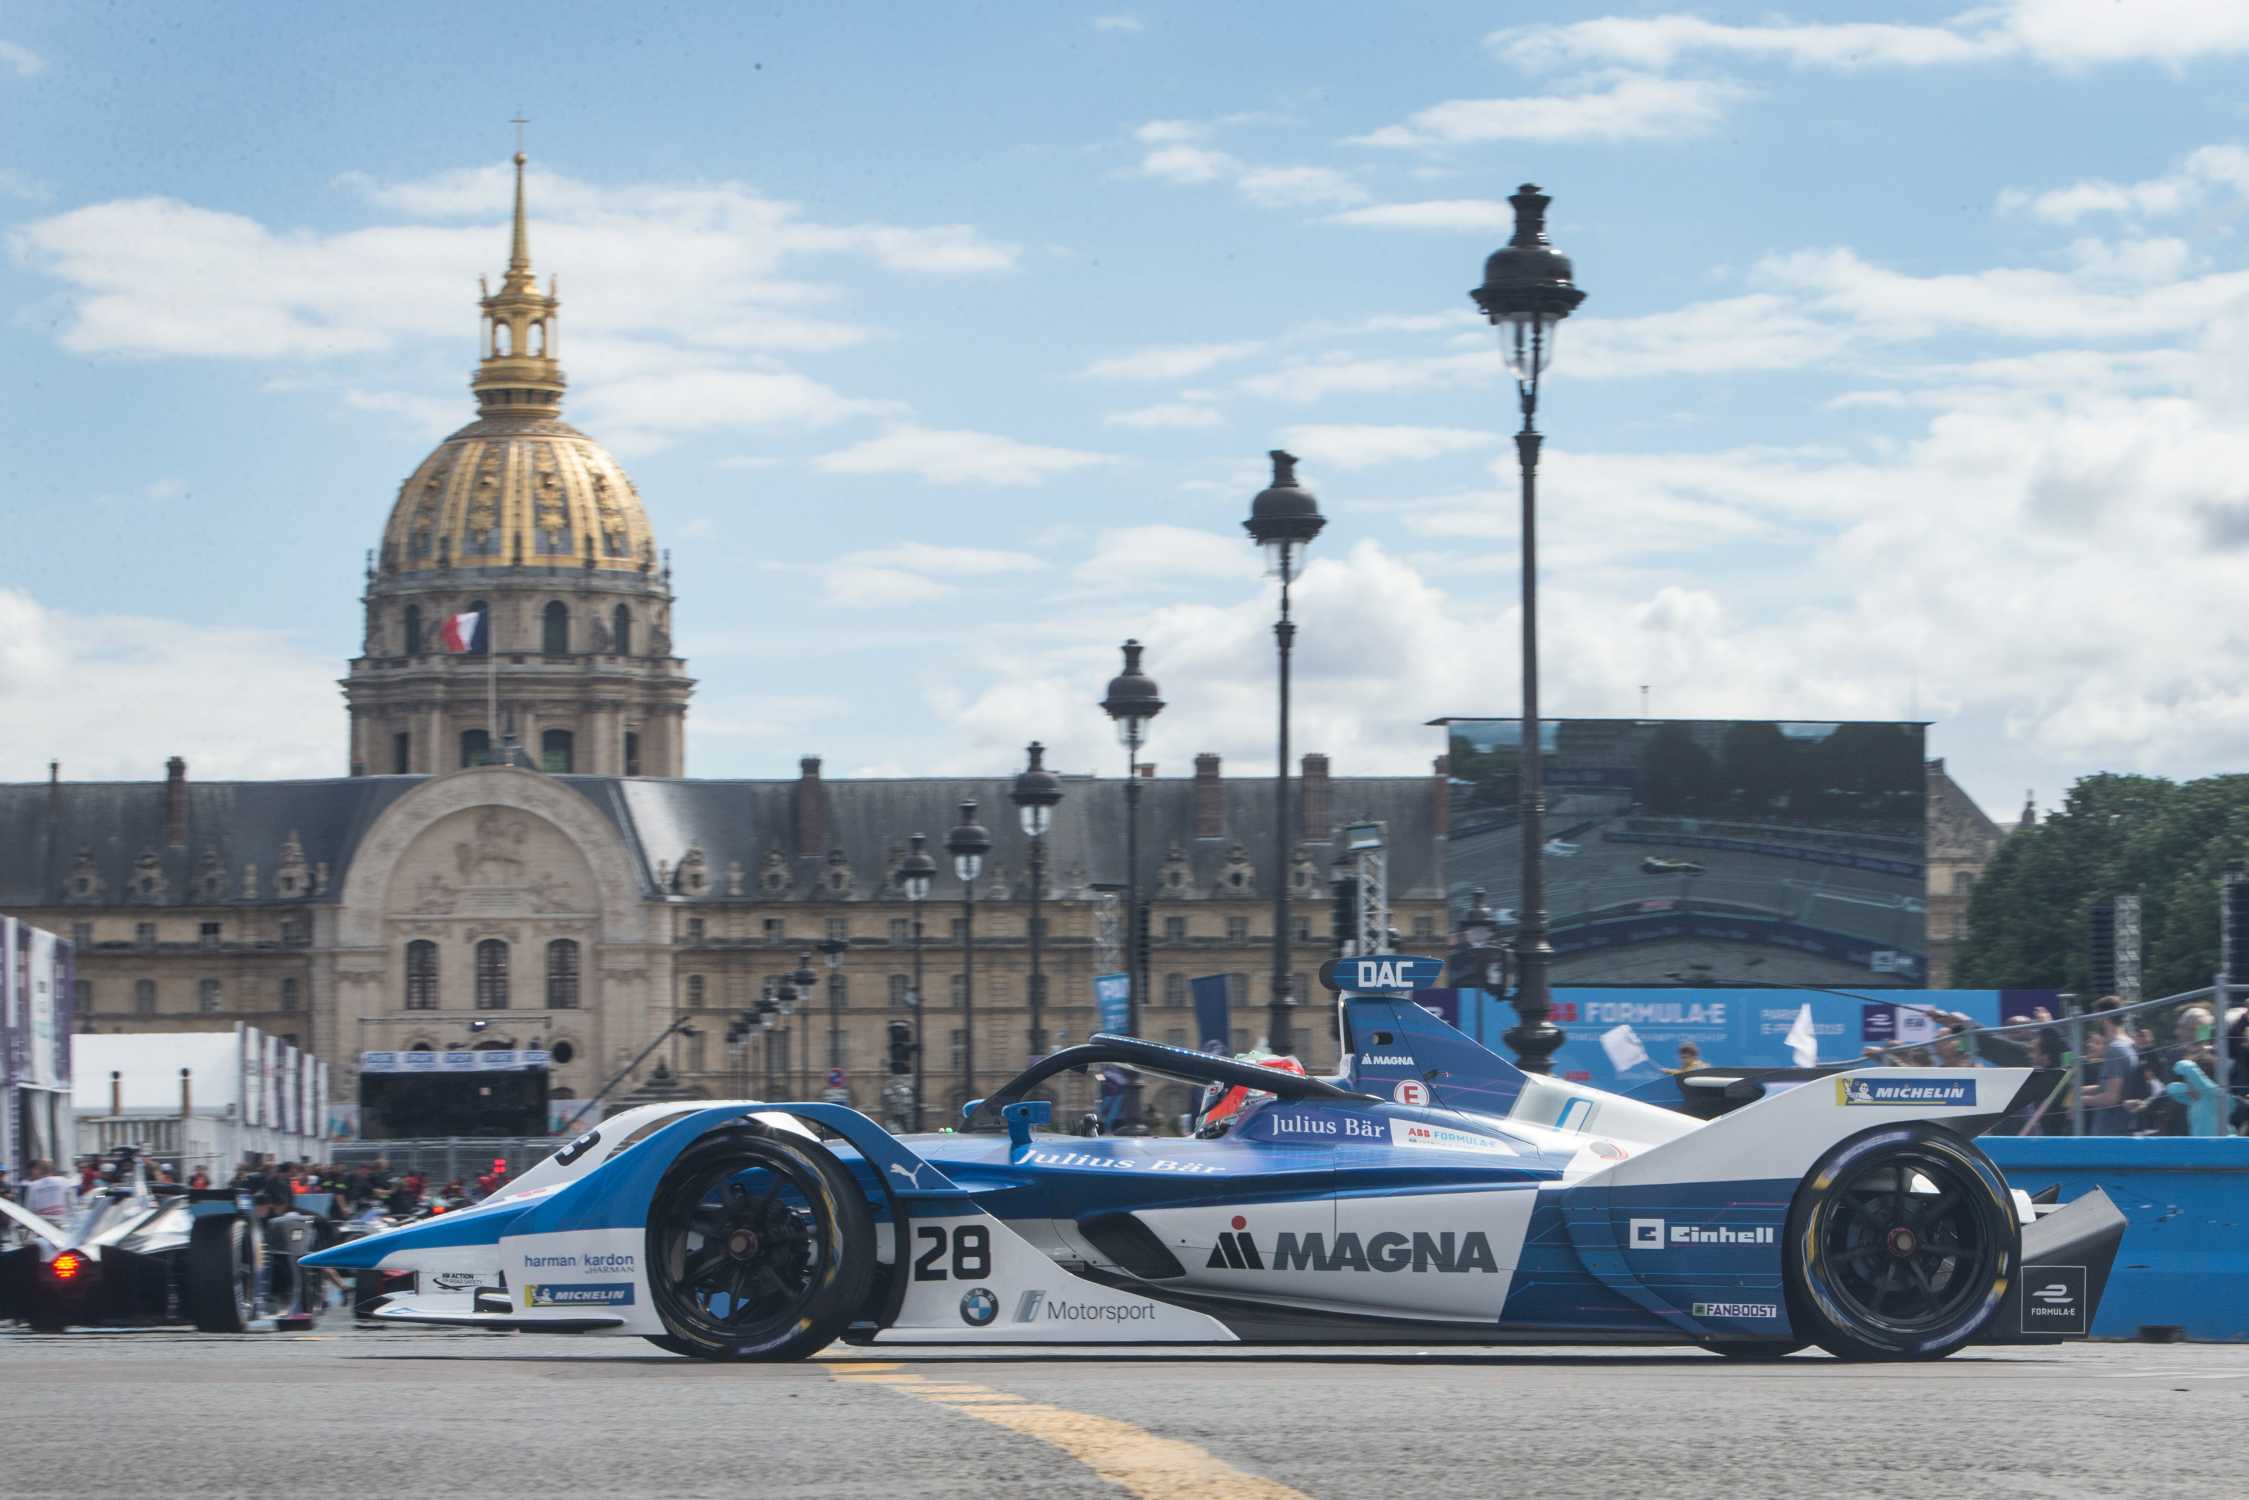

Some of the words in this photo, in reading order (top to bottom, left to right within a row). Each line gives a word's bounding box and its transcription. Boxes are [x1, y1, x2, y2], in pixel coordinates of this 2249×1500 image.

[1358, 961, 1414, 988] DAC
[1373, 1056, 1415, 1066] MAGNA
[1403, 1085, 1420, 1105] E
[1875, 1087, 1964, 1099] MICHELIN
[1271, 1114, 1337, 1136] Julius
[1344, 1117, 1385, 1138] Bär
[1407, 1128, 1431, 1138] ABB
[1014, 1149, 1136, 1169] Julius
[1670, 1226, 1774, 1244] Einhell
[914, 1224, 991, 1282] 28
[1272, 1231, 1499, 1274] MAGNA
[554, 1290, 625, 1301] MICHELIN
[1047, 1301, 1156, 1324] Motorsport
[1706, 1304, 1776, 1317] FANBOOST
